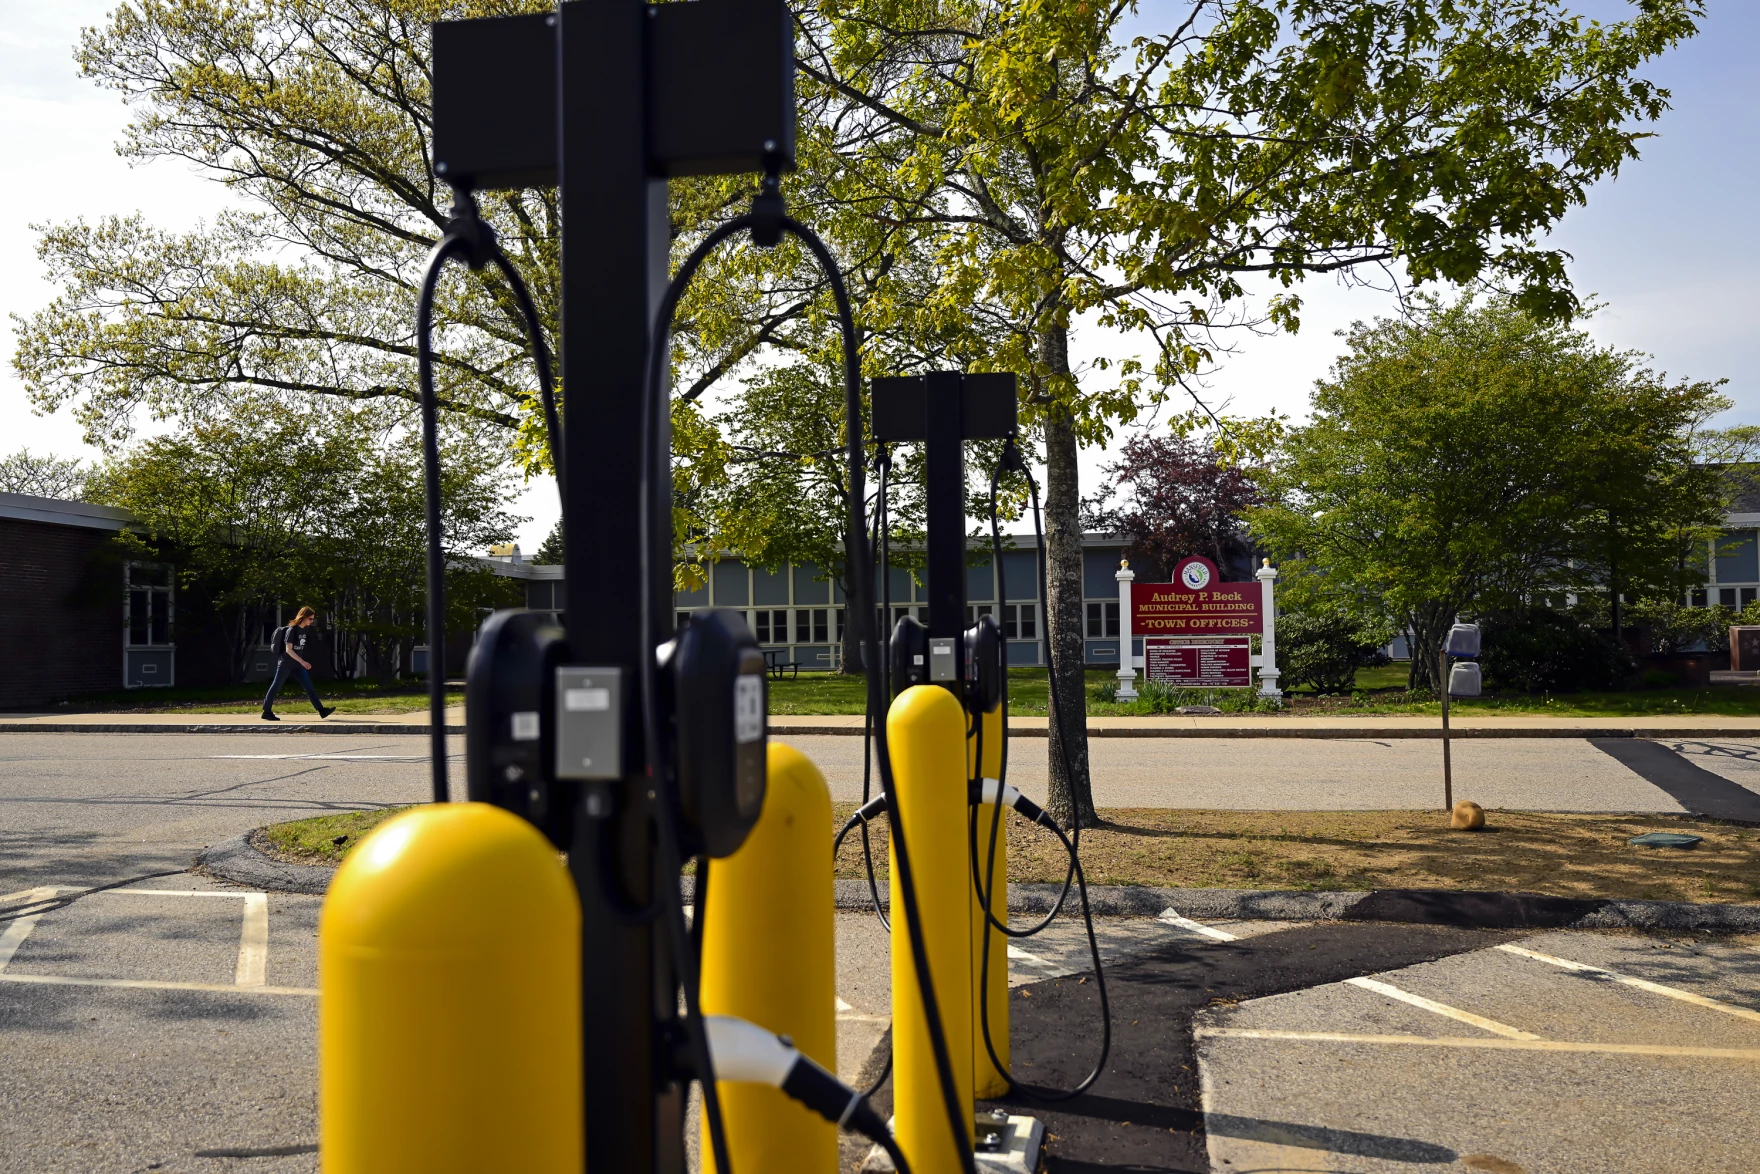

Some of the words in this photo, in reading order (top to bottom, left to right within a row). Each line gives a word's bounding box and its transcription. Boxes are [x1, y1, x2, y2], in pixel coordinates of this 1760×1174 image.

[1183, 563, 1209, 577] MANSFIELD
[1151, 592, 1195, 603] Audrey
[1199, 592, 1208, 601] P.
[1212, 591, 1242, 601] Beck
[1202, 603, 1255, 611] BUILDING
[1146, 619, 1186, 628] TOWN
[1190, 618, 1248, 628] OFFICES
